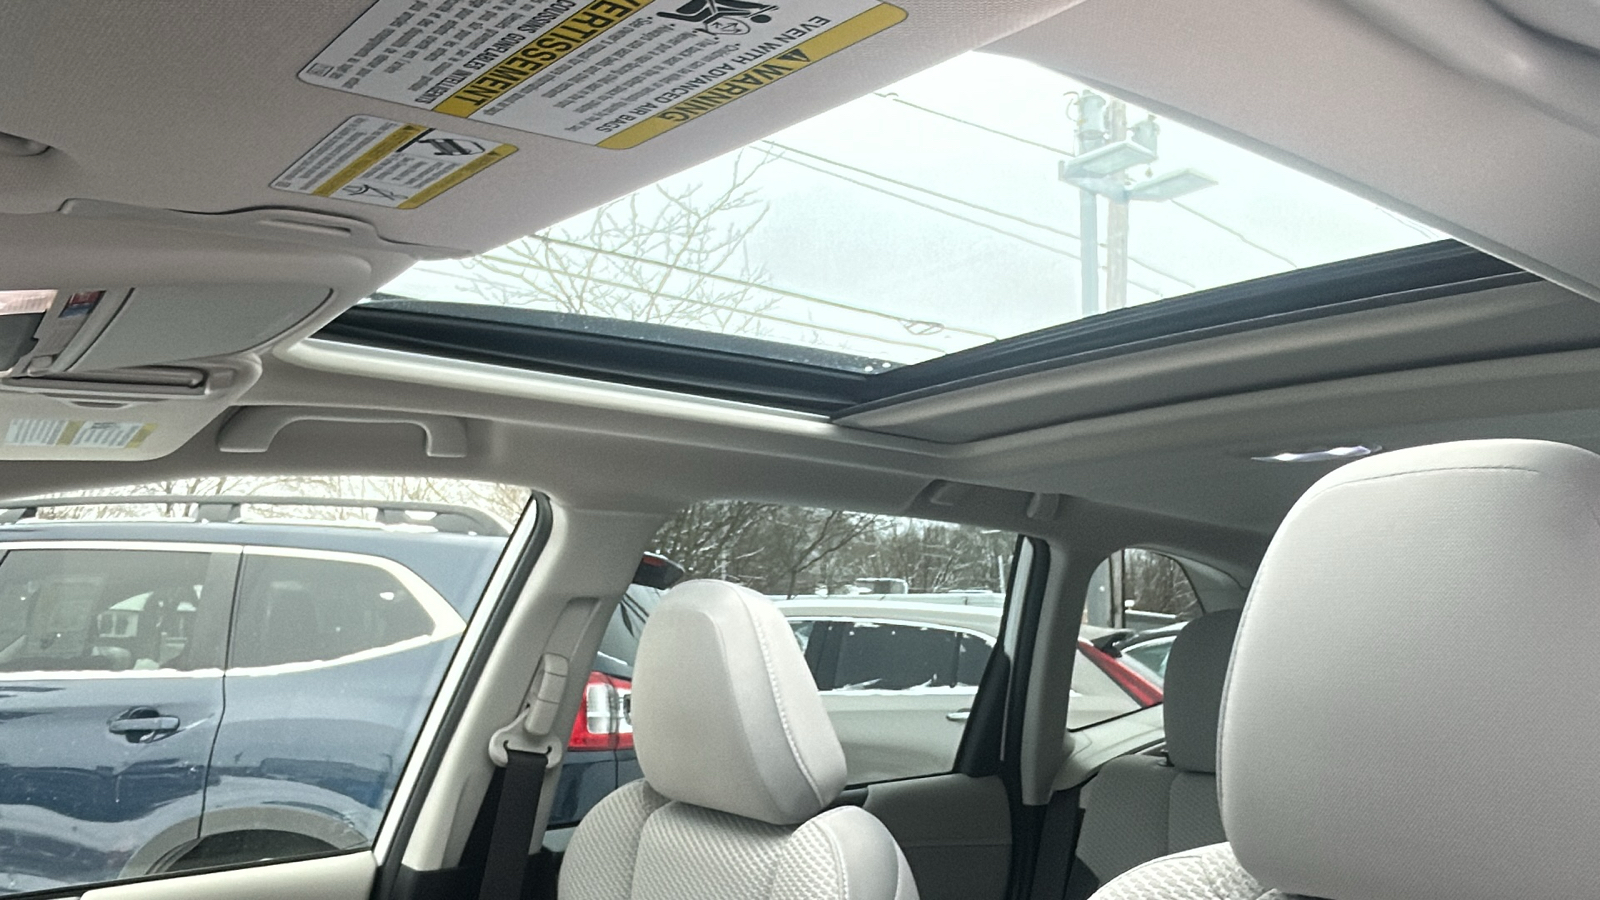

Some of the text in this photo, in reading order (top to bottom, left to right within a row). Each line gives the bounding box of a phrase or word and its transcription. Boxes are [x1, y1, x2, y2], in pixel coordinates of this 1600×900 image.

[516, 0, 576, 33] COUSSINS
[774, 16, 831, 43] EVEN
[452, 0, 639, 106] ERTISSEMENT
[729, 41, 782, 64] WITH
[650, 63, 739, 104] ADVANCED
[658, 62, 793, 122] WARNING
[594, 115, 637, 132] BAGS
[628, 102, 661, 115] AIR
